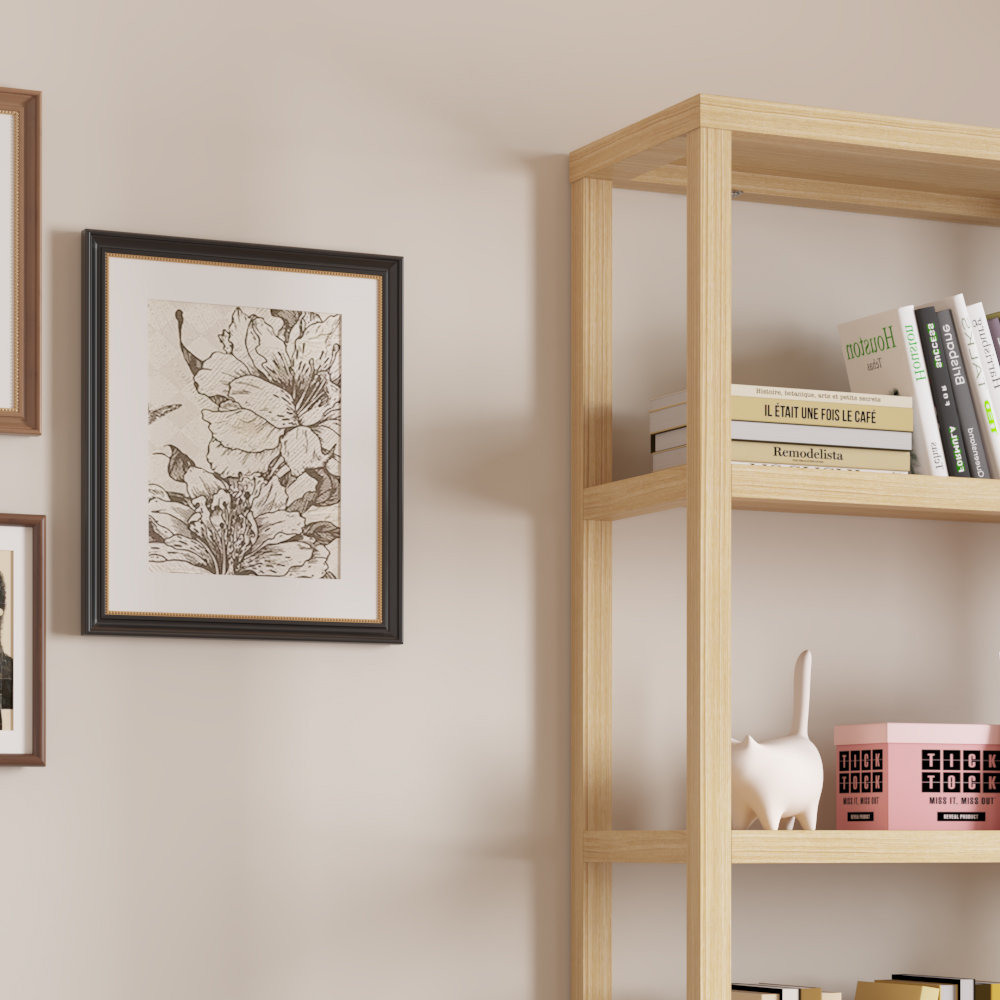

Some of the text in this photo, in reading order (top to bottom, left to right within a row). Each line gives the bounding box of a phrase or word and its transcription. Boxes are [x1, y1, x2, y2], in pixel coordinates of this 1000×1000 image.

[764, 402, 877, 424] IL ÉTAIT UNE FOIS LE CAFÉ
[772, 446, 844, 461] Remodelista
[841, 751, 881, 769] TICK
[926, 752, 997, 769] TICK
[841, 774, 881, 791] TOCK
[926, 774, 997, 790] TOCK
[929, 797, 947, 805] MISS
[961, 797, 979, 805] MISS
[981, 797, 994, 805] OUT
